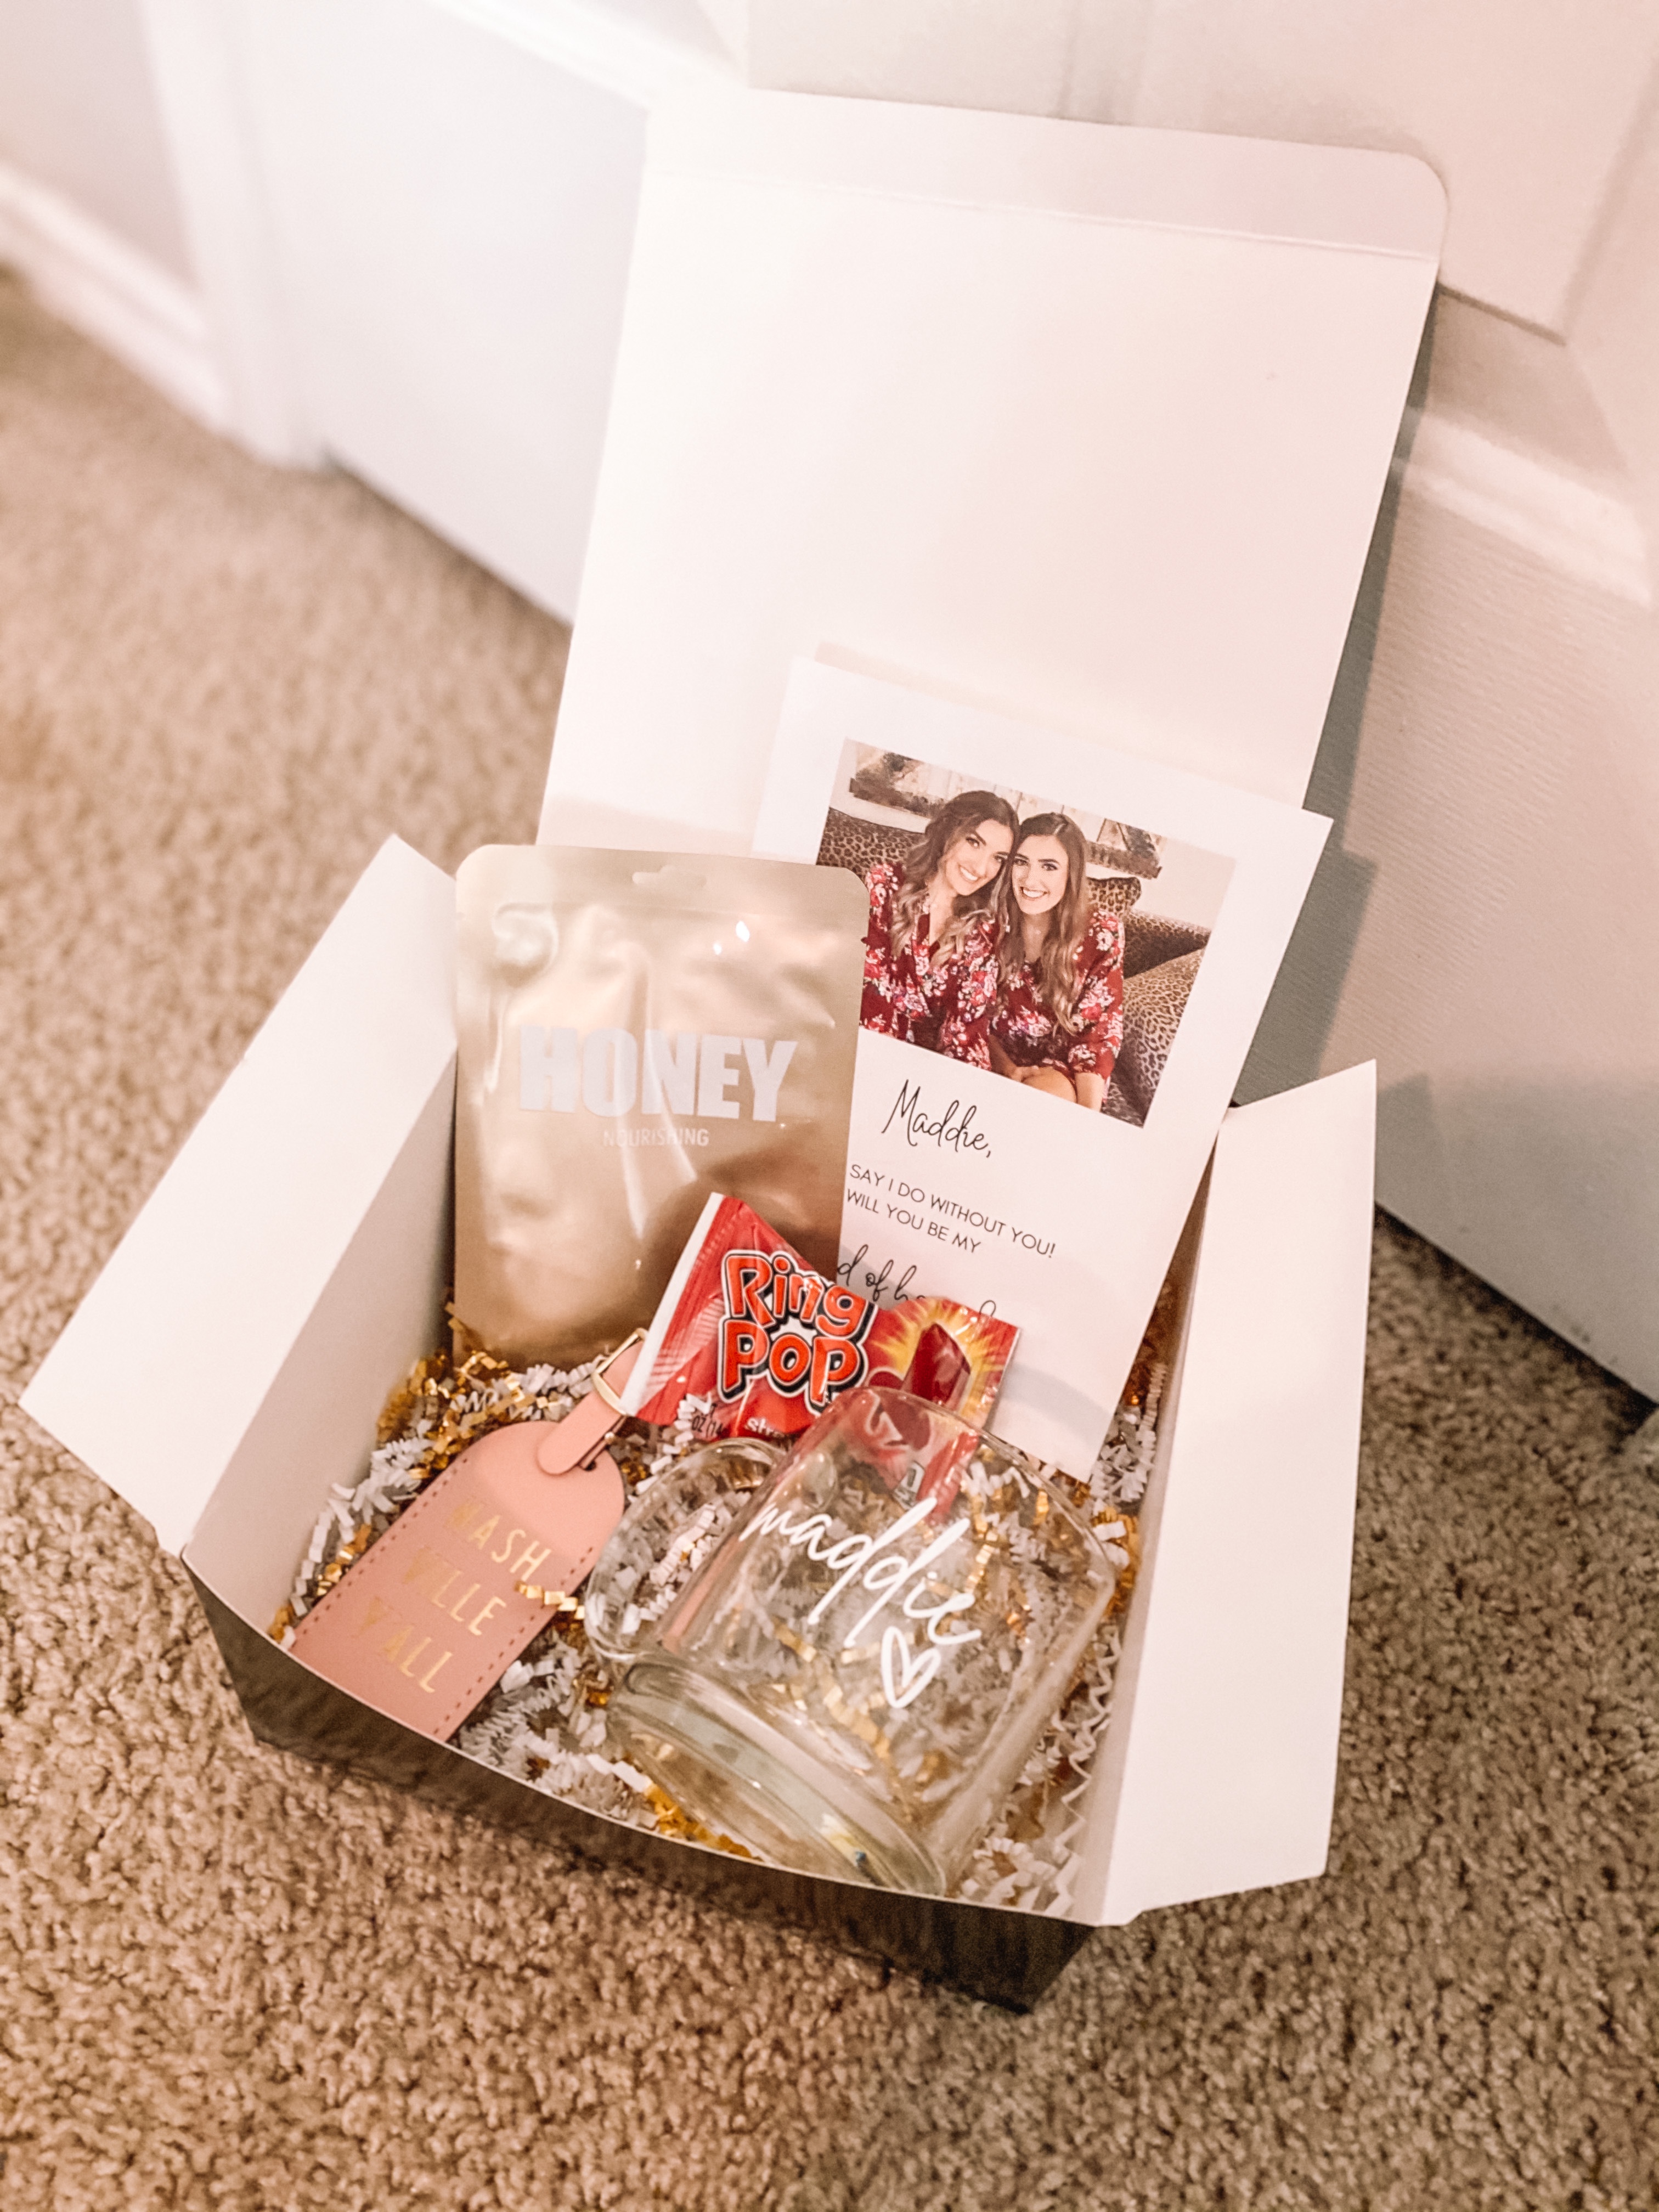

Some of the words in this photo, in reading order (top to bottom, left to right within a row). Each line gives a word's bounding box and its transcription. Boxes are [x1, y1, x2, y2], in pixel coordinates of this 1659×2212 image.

[520, 1025, 799, 1122] HONEY
[881, 1079, 991, 1159] Maddie,
[847, 1188, 879, 1214] WILL
[887, 1204, 924, 1231] YOU
[928, 1221, 949, 1241] BE
[952, 1233, 981, 1253] MY
[849, 1164, 885, 1187] SAY
[888, 1178, 894, 1192] I
[898, 1182, 925, 1203] DO
[932, 1194, 1006, 1237] WITHOUT
[1012, 1227, 1056, 1258] YOU!
[723, 1251, 873, 1338] Ring
[865, 1259, 894, 1301] of
[402, 1544, 506, 1636] VLLE
